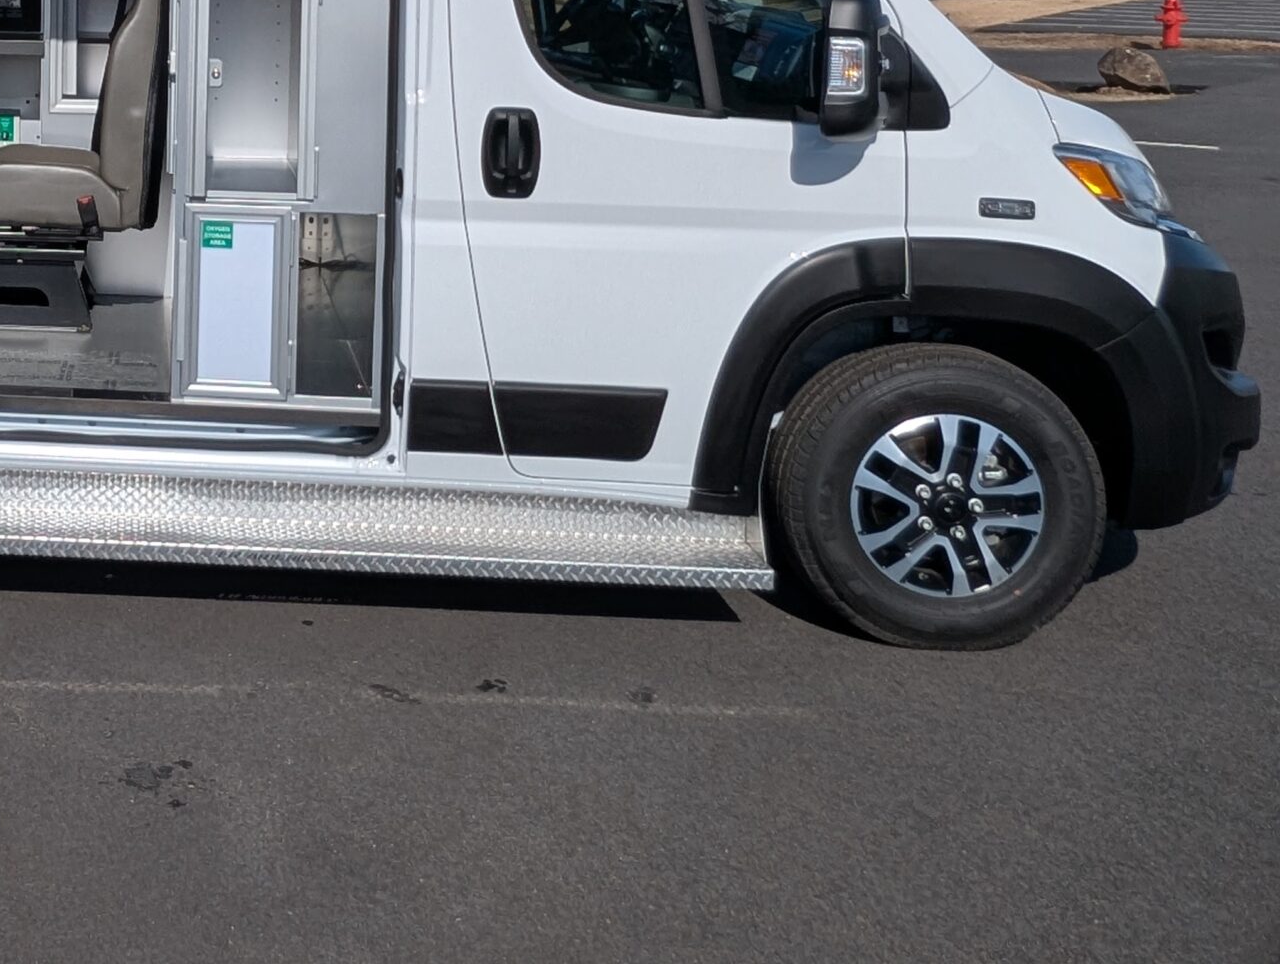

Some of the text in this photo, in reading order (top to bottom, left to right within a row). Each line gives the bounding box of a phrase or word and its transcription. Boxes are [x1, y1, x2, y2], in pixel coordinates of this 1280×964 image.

[205, 225, 231, 233] OXYGEN
[204, 231, 232, 240] STORAGE
[209, 238, 226, 246] AREA
